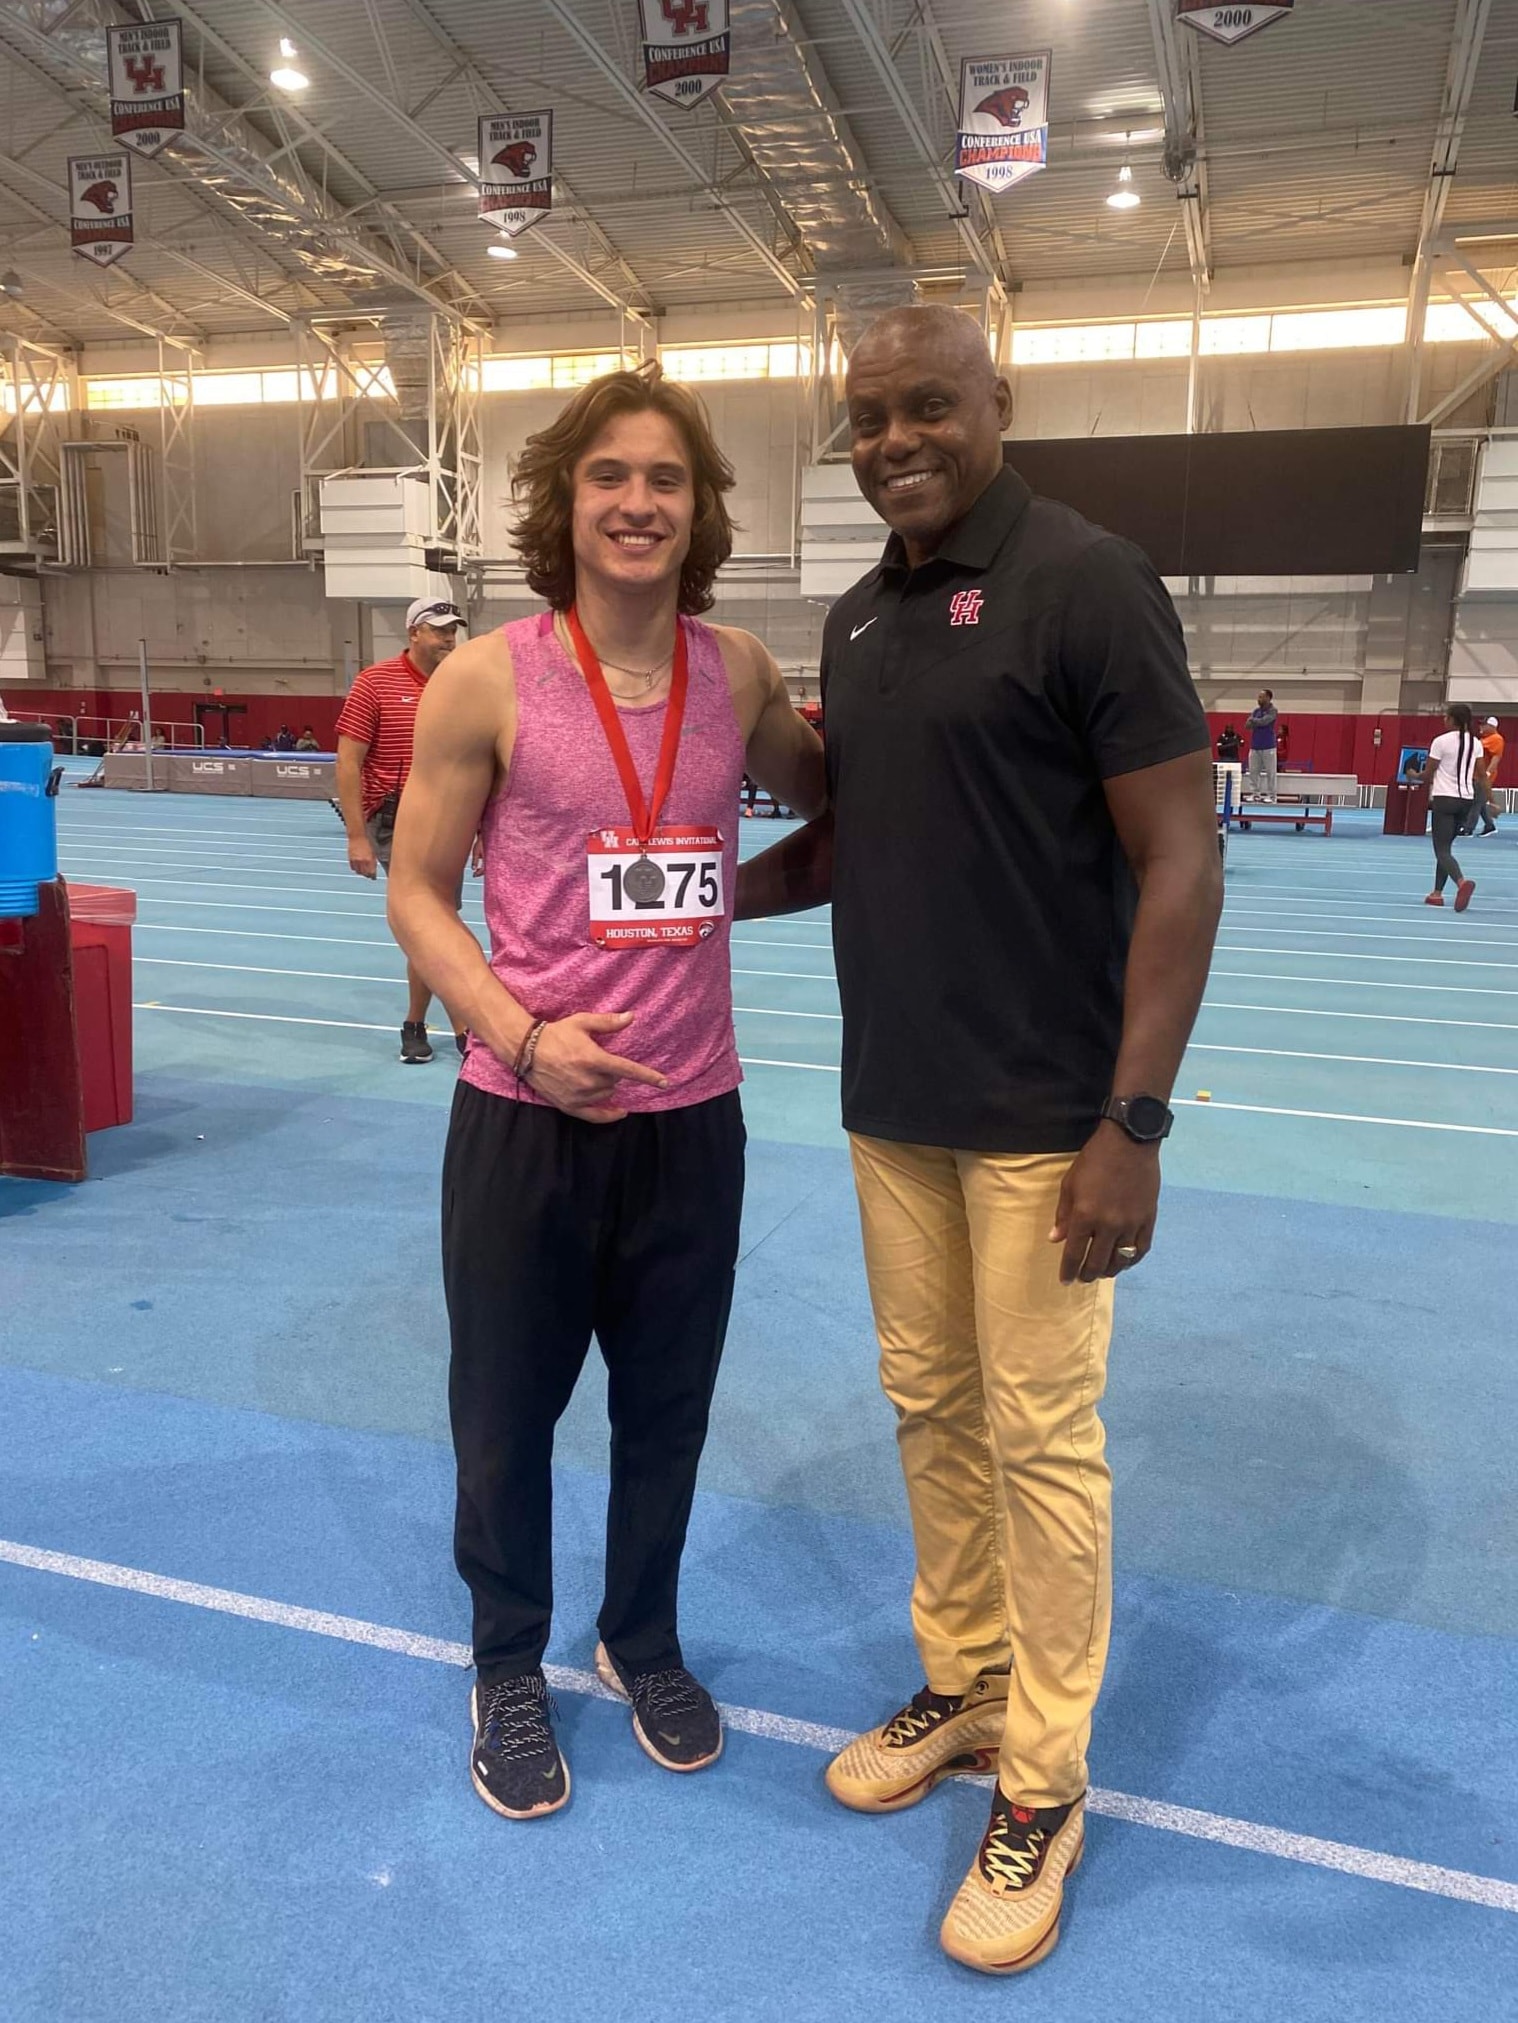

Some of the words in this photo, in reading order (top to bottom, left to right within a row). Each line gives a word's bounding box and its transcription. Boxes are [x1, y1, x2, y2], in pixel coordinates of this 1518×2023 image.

[1213, 9, 1252, 28] 2000
[118, 43, 140, 54] TRACK
[151, 39, 171, 50] FIELD
[648, 42, 708, 63] CONFERENCE
[709, 36, 726, 53] USA
[969, 63, 1006, 75] WOMEN'S
[1009, 59, 1042, 72] INDOOR
[973, 75, 1000, 86] TRACK
[1003, 74, 1010, 85] &
[1013, 71, 1037, 84] FIELD
[675, 79, 702, 96] 2000
[114, 99, 162, 115] CONFERENCE
[165, 96, 180, 110] USA
[136, 131, 160, 147] 2000
[490, 131, 512, 141] TRACK
[522, 128, 541, 138] FIELD
[961, 133, 1020, 149] CONFERENCE
[1023, 129, 1041, 144] USA
[960, 143, 1042, 167] CHAMPIONS
[986, 166, 1013, 180] 1998
[481, 183, 530, 195] CONFERENCE
[533, 179, 547, 192] USA
[503, 211, 526, 223] 1998
[94, 244, 113, 256] 1997
[192, 762, 223, 771] UCS
[276, 765, 309, 775] UCS
[648, 838, 673, 846] LEWIS
[601, 862, 718, 910] 175
[606, 928, 657, 938] HOUSTON,
[661, 926, 693, 936] TEXAS
